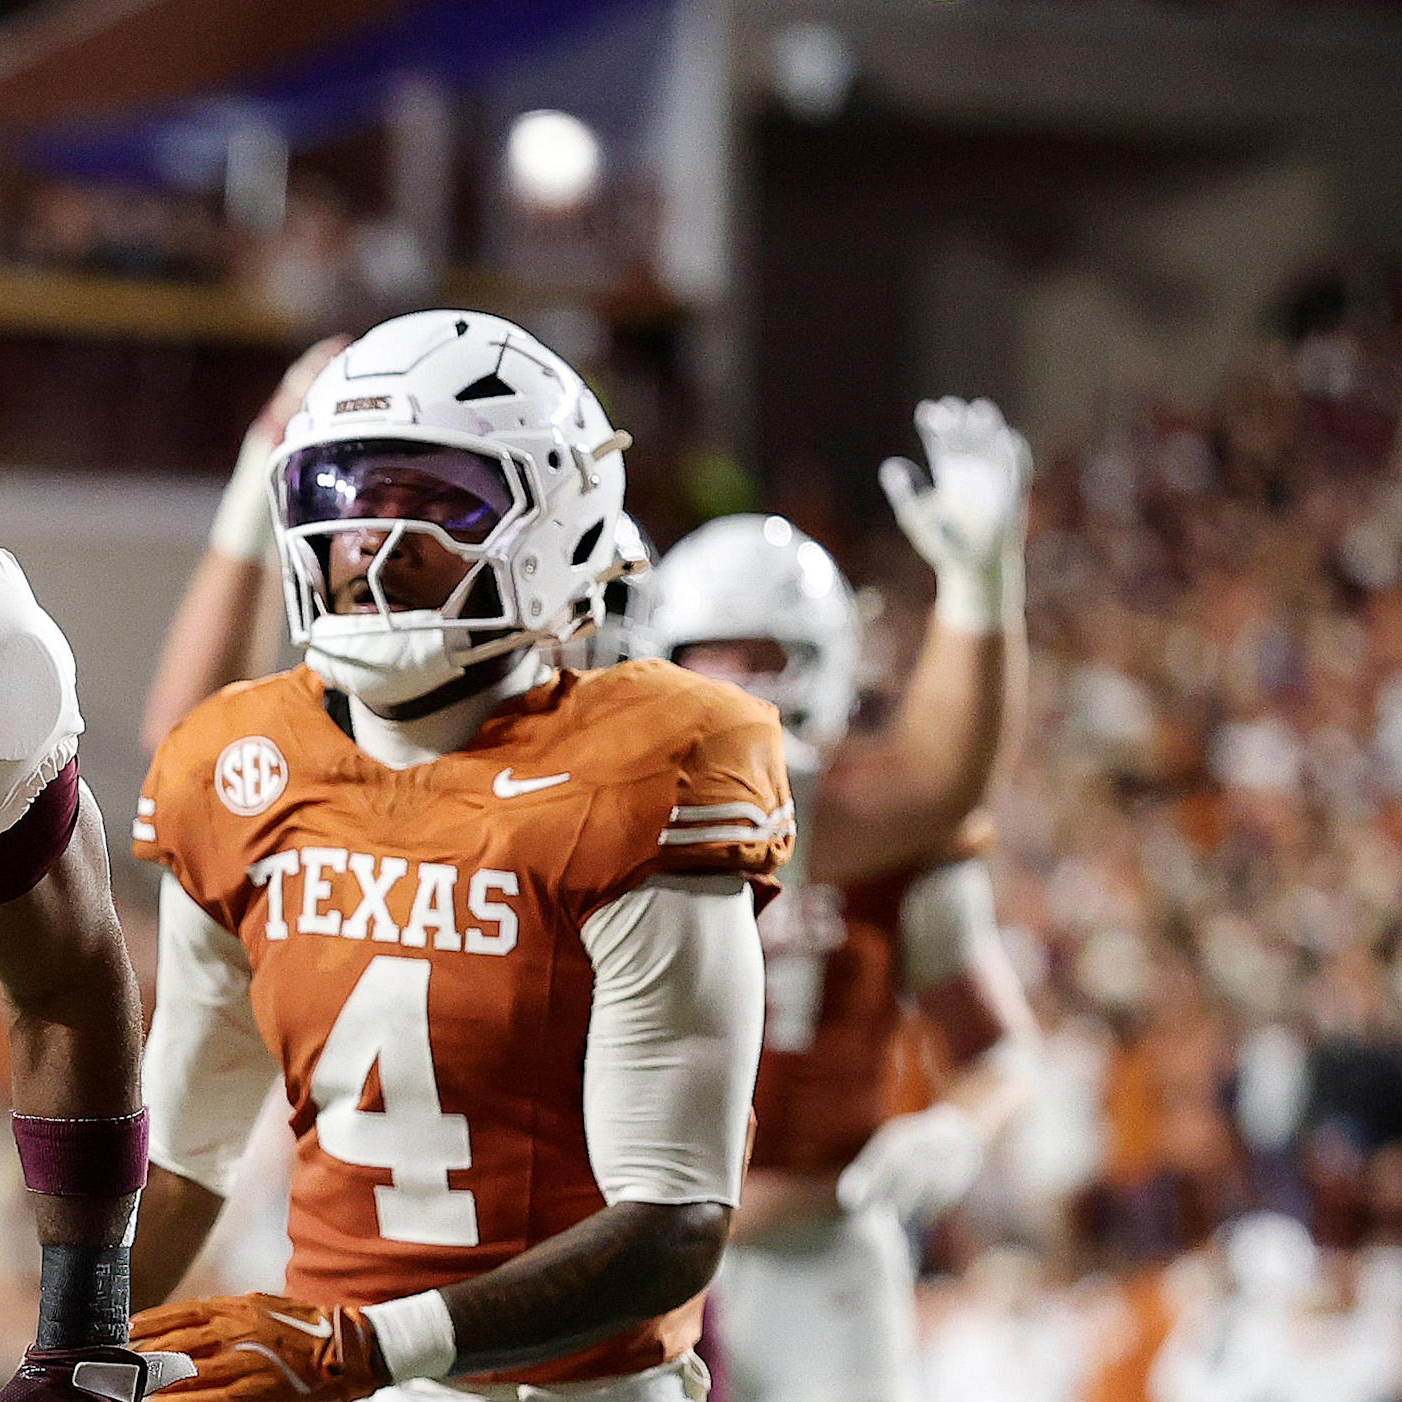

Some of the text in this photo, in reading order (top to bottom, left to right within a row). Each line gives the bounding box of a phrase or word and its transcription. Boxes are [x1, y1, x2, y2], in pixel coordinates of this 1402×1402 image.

[221, 742, 282, 808] SEC
[246, 847, 520, 956] TEXAS
[311, 954, 479, 1247] 4
